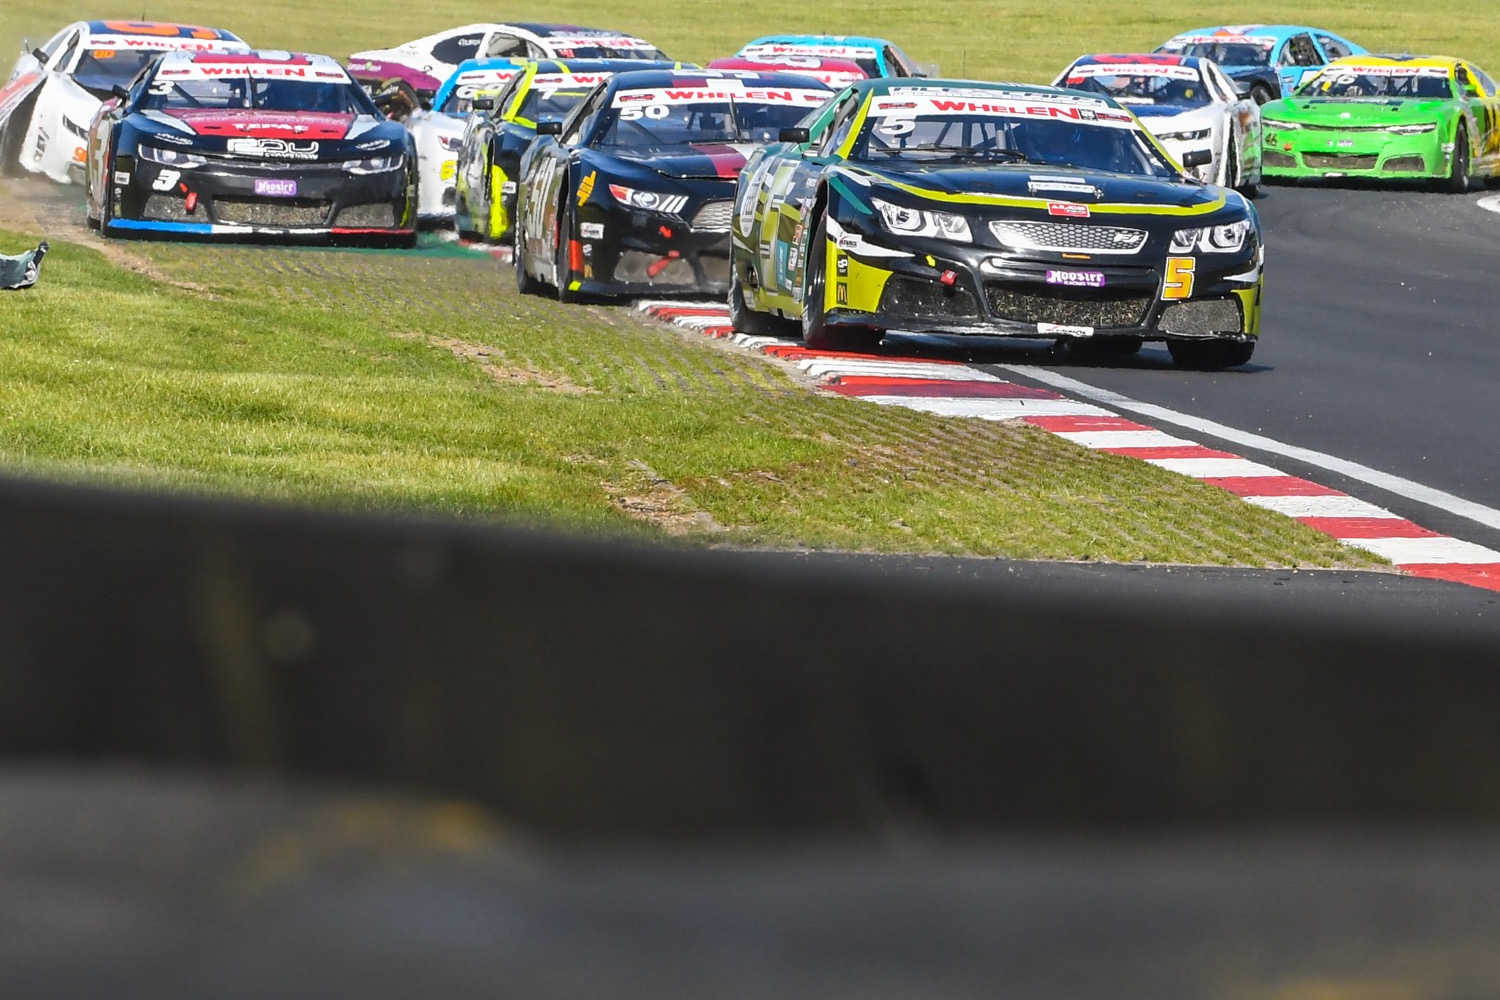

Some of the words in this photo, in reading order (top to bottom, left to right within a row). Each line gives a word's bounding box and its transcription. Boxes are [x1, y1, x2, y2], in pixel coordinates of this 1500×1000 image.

[124, 39, 214, 50] WHELEN
[201, 67, 305, 77] WHELEN
[148, 80, 175, 95] 3
[664, 90, 793, 101] WHELEN
[619, 104, 670, 121] 50
[930, 99, 1080, 120] WHELEN
[880, 114, 916, 135] 5
[1265, 132, 1278, 146] 46
[152, 169, 181, 191] 3
[256, 180, 295, 194] Hoosier
[1047, 270, 1104, 284] Hoosier
[1161, 257, 1196, 301] 5
